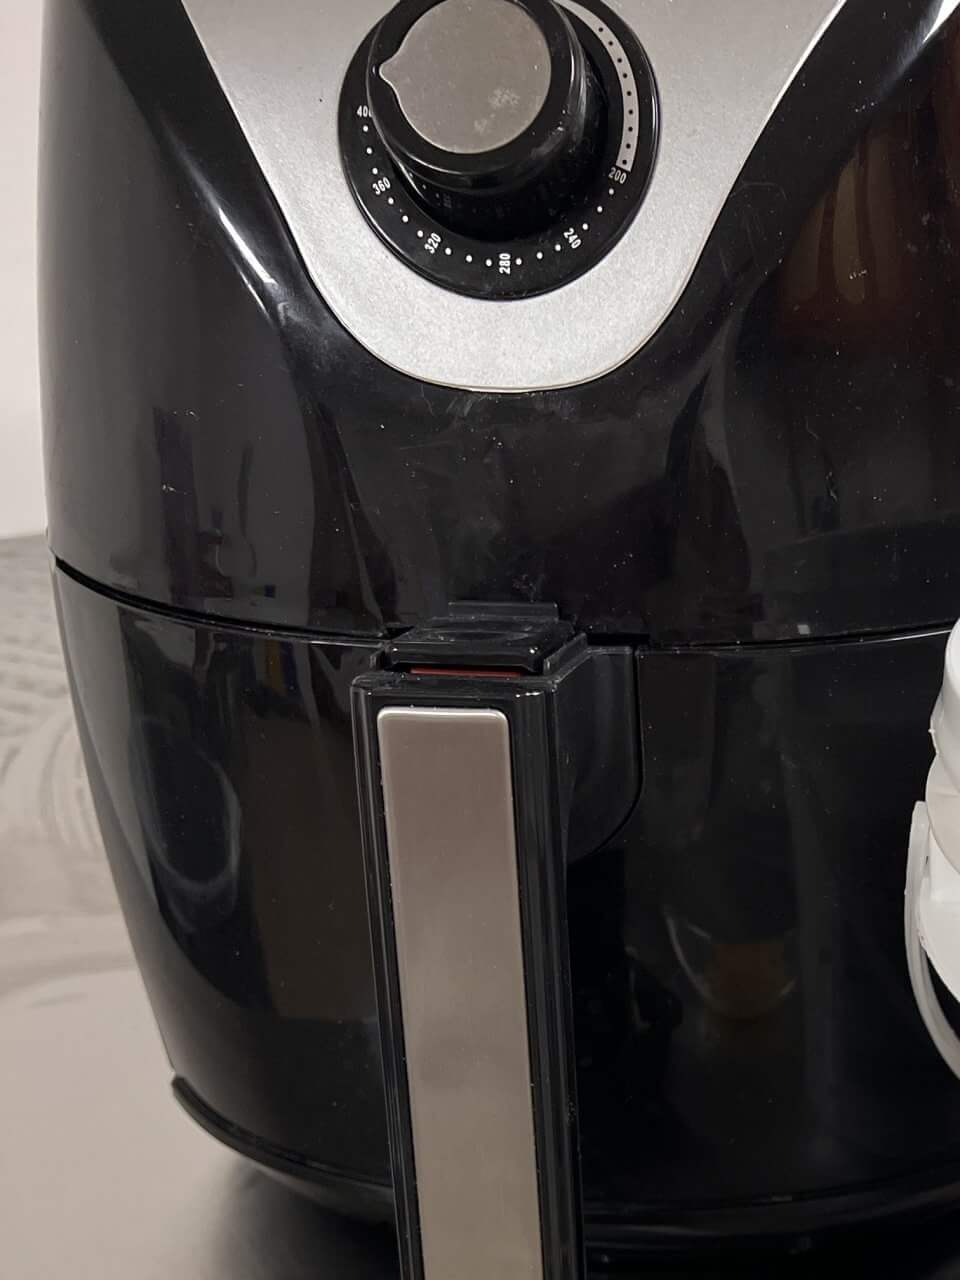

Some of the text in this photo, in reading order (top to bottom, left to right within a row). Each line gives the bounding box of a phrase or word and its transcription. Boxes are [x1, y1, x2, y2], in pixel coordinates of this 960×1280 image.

[372, 176, 391, 195] 360
[608, 167, 627, 184] 200
[424, 232, 441, 254] 320
[563, 227, 581, 249] 240
[499, 252, 511, 274] 280
